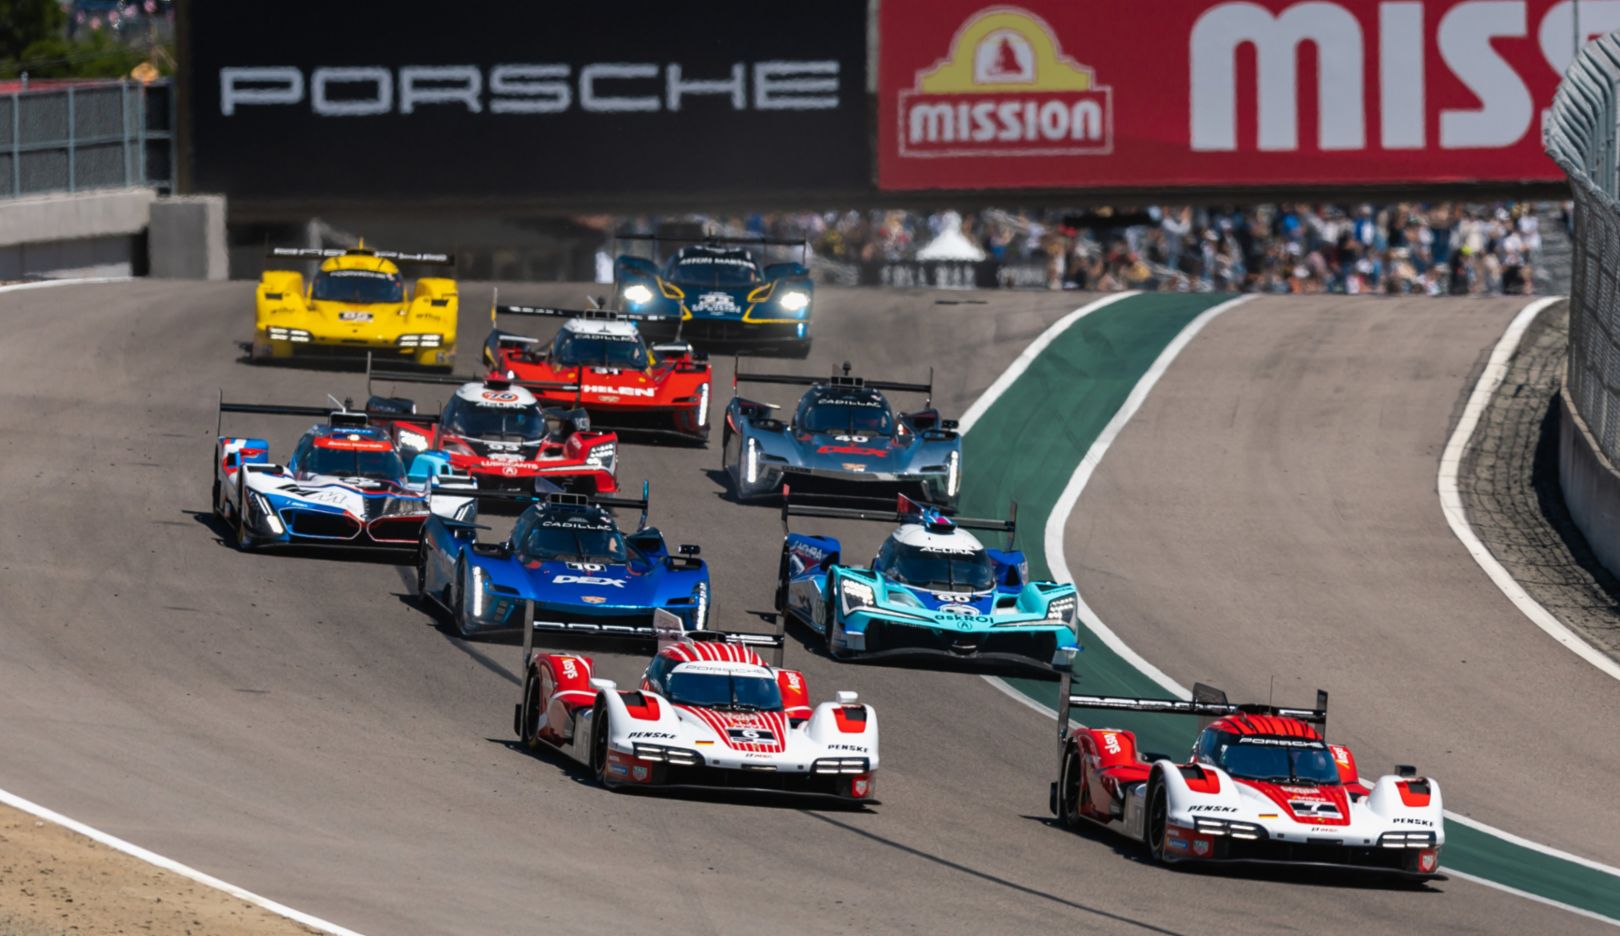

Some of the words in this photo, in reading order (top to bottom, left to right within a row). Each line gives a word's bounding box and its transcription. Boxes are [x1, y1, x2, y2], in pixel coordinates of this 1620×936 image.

[220, 61, 840, 116] PORSCHE
[908, 99, 1103, 143] MISSION
[581, 384, 654, 397] HELEN
[818, 398, 881, 407] CADILLAC
[834, 434, 869, 443] 40
[542, 520, 613, 531] CADILLAC
[919, 546, 975, 555] ACURA
[574, 562, 602, 571] 10
[552, 575, 626, 588] DEX
[938, 594, 970, 602] 60
[935, 612, 994, 624] askROI
[627, 731, 678, 740] PENSKE
[741, 729, 760, 739] 6
[1239, 736, 1324, 749] PORSCHE
[827, 743, 869, 754] PENSKE
[1186, 804, 1239, 813] PENSKE
[1392, 817, 1434, 828] PENSKE
